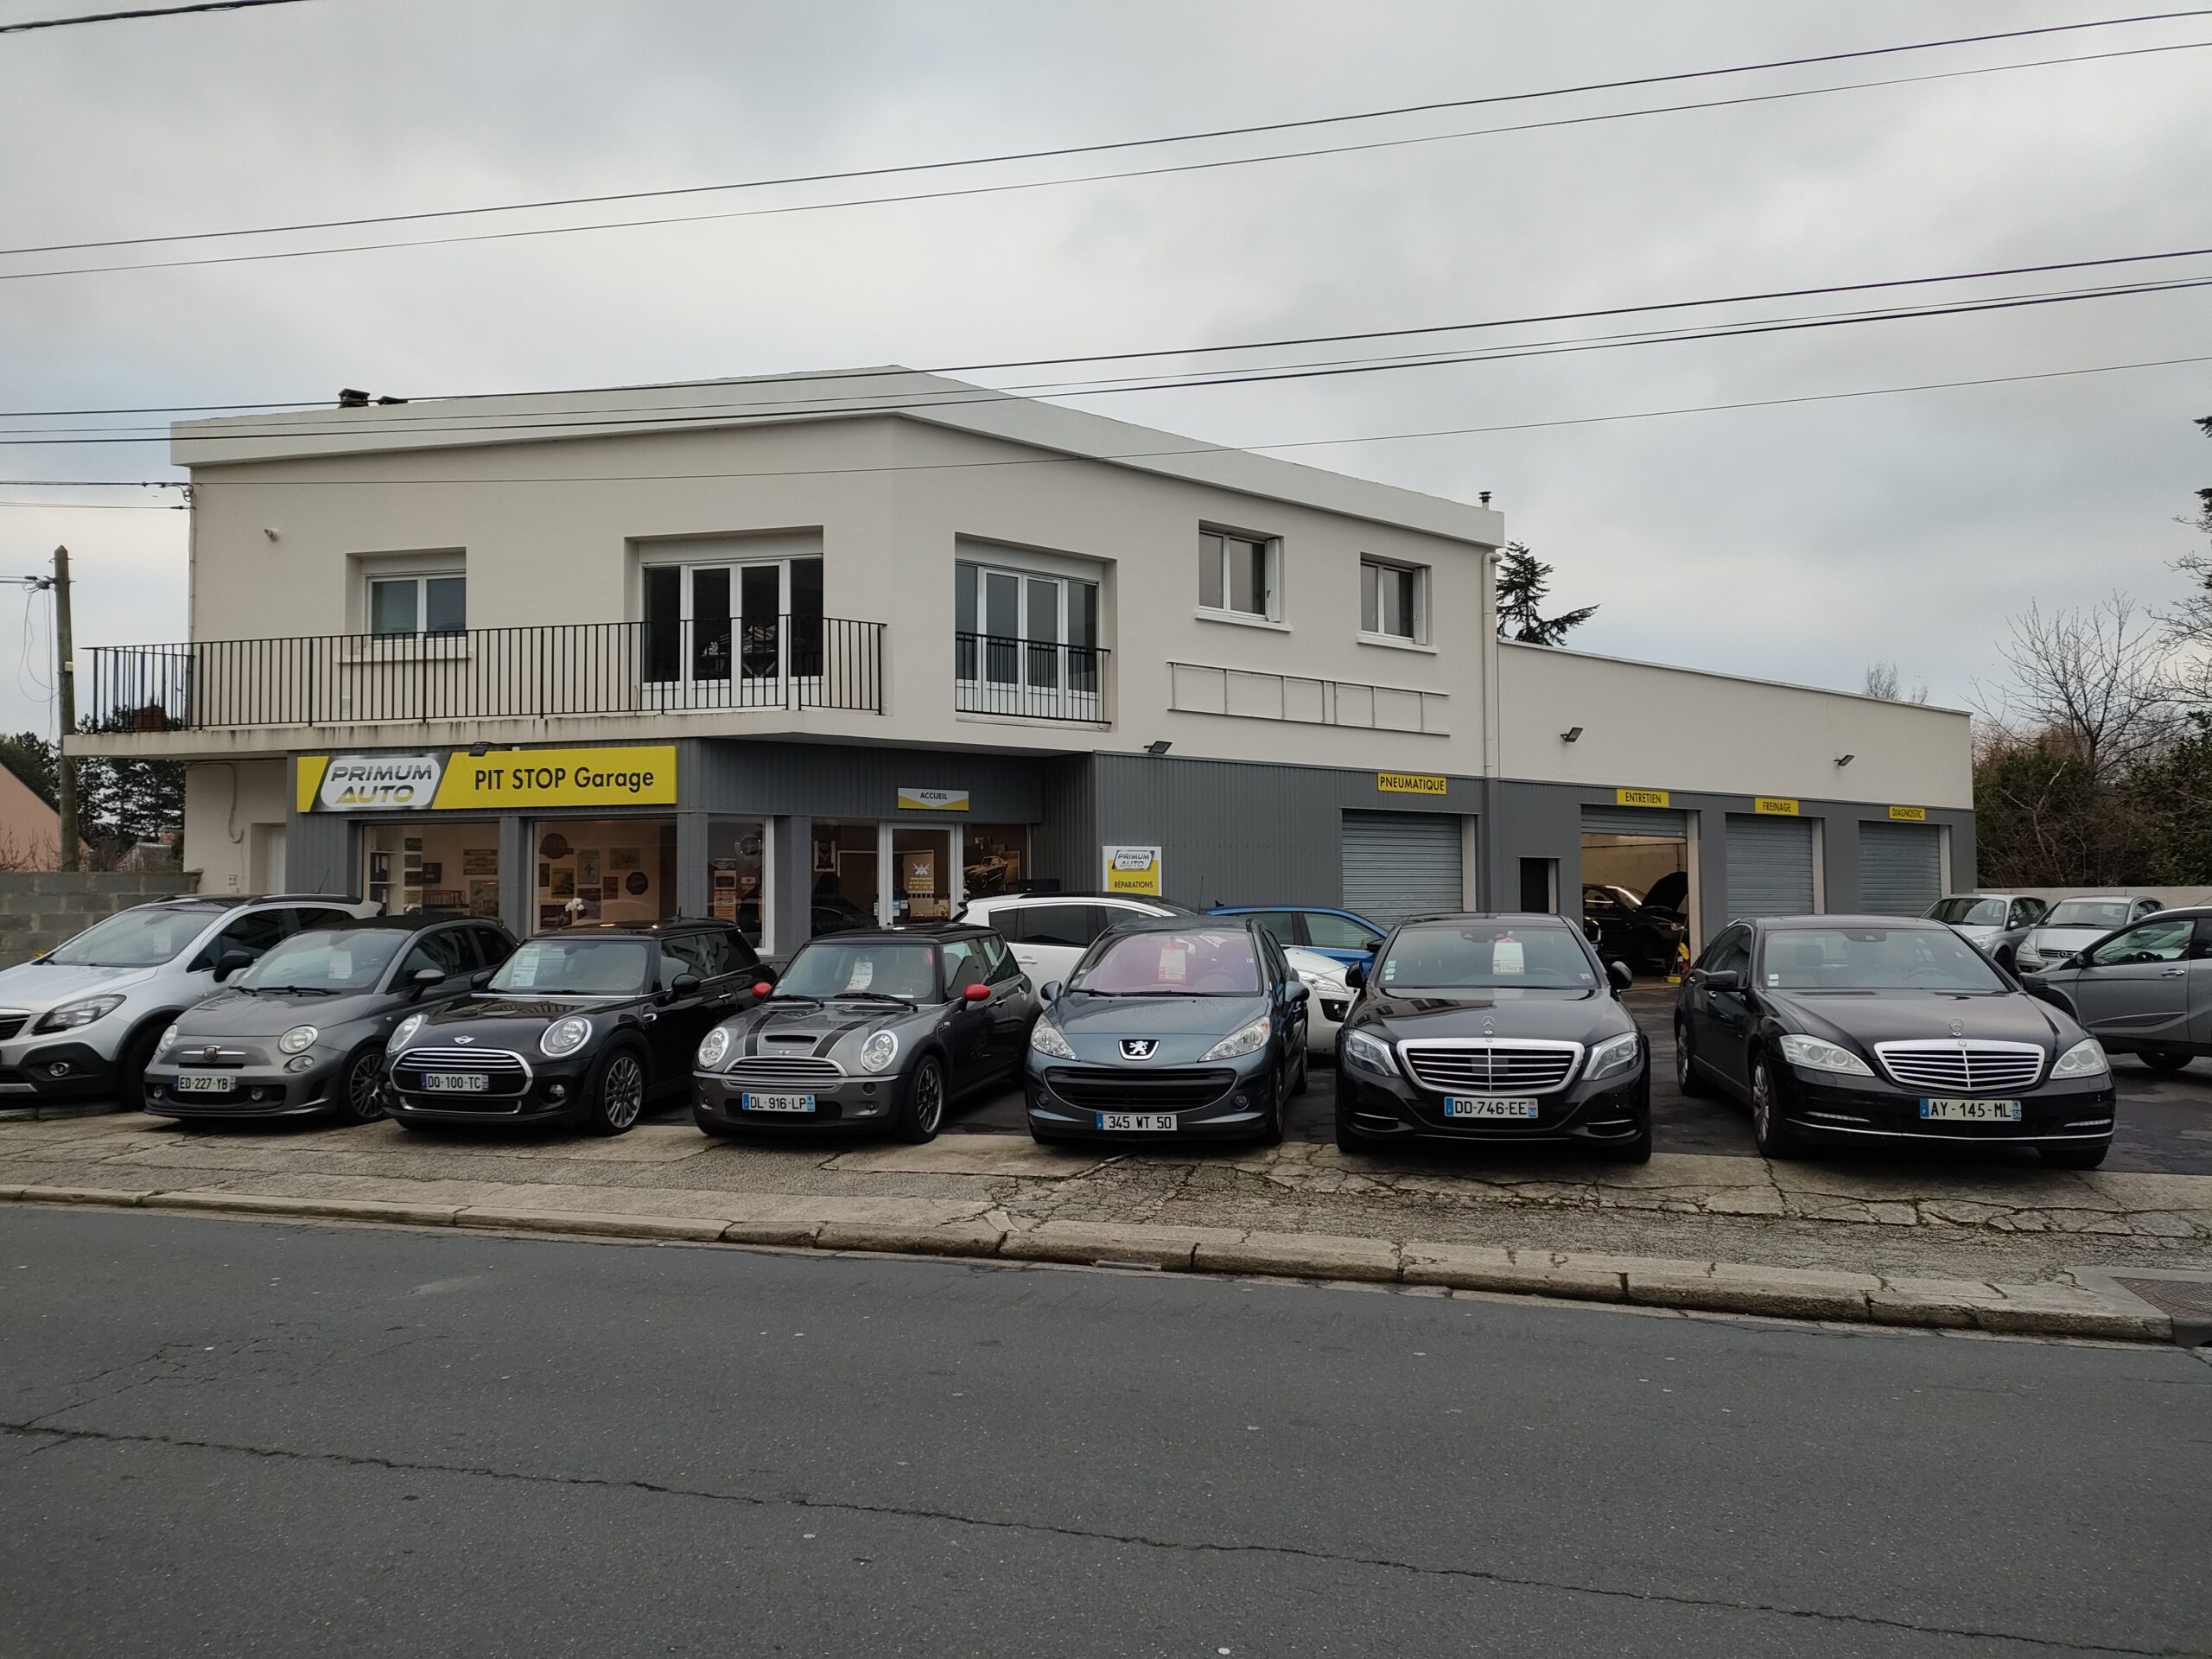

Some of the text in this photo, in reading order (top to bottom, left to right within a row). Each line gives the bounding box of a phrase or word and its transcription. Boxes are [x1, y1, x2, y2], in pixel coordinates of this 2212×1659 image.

[331, 765, 432, 781] PRIMUM
[475, 766, 654, 793] PIT STOP Garage
[1380, 776, 1445, 791] PNEUMATIQUE
[335, 785, 415, 804] AUTO
[919, 791, 948, 800] ACCUEIL
[1624, 791, 1662, 804] ENTRETIEN
[1763, 801, 1791, 812] FREINAGE
[1114, 879, 1154, 888] RÉPARATIONS
[180, 1077, 228, 1090] ED-227-YB
[1455, 1101, 1527, 1115] DD-746-EE
[1108, 1116, 1172, 1128] 345 WT 50
